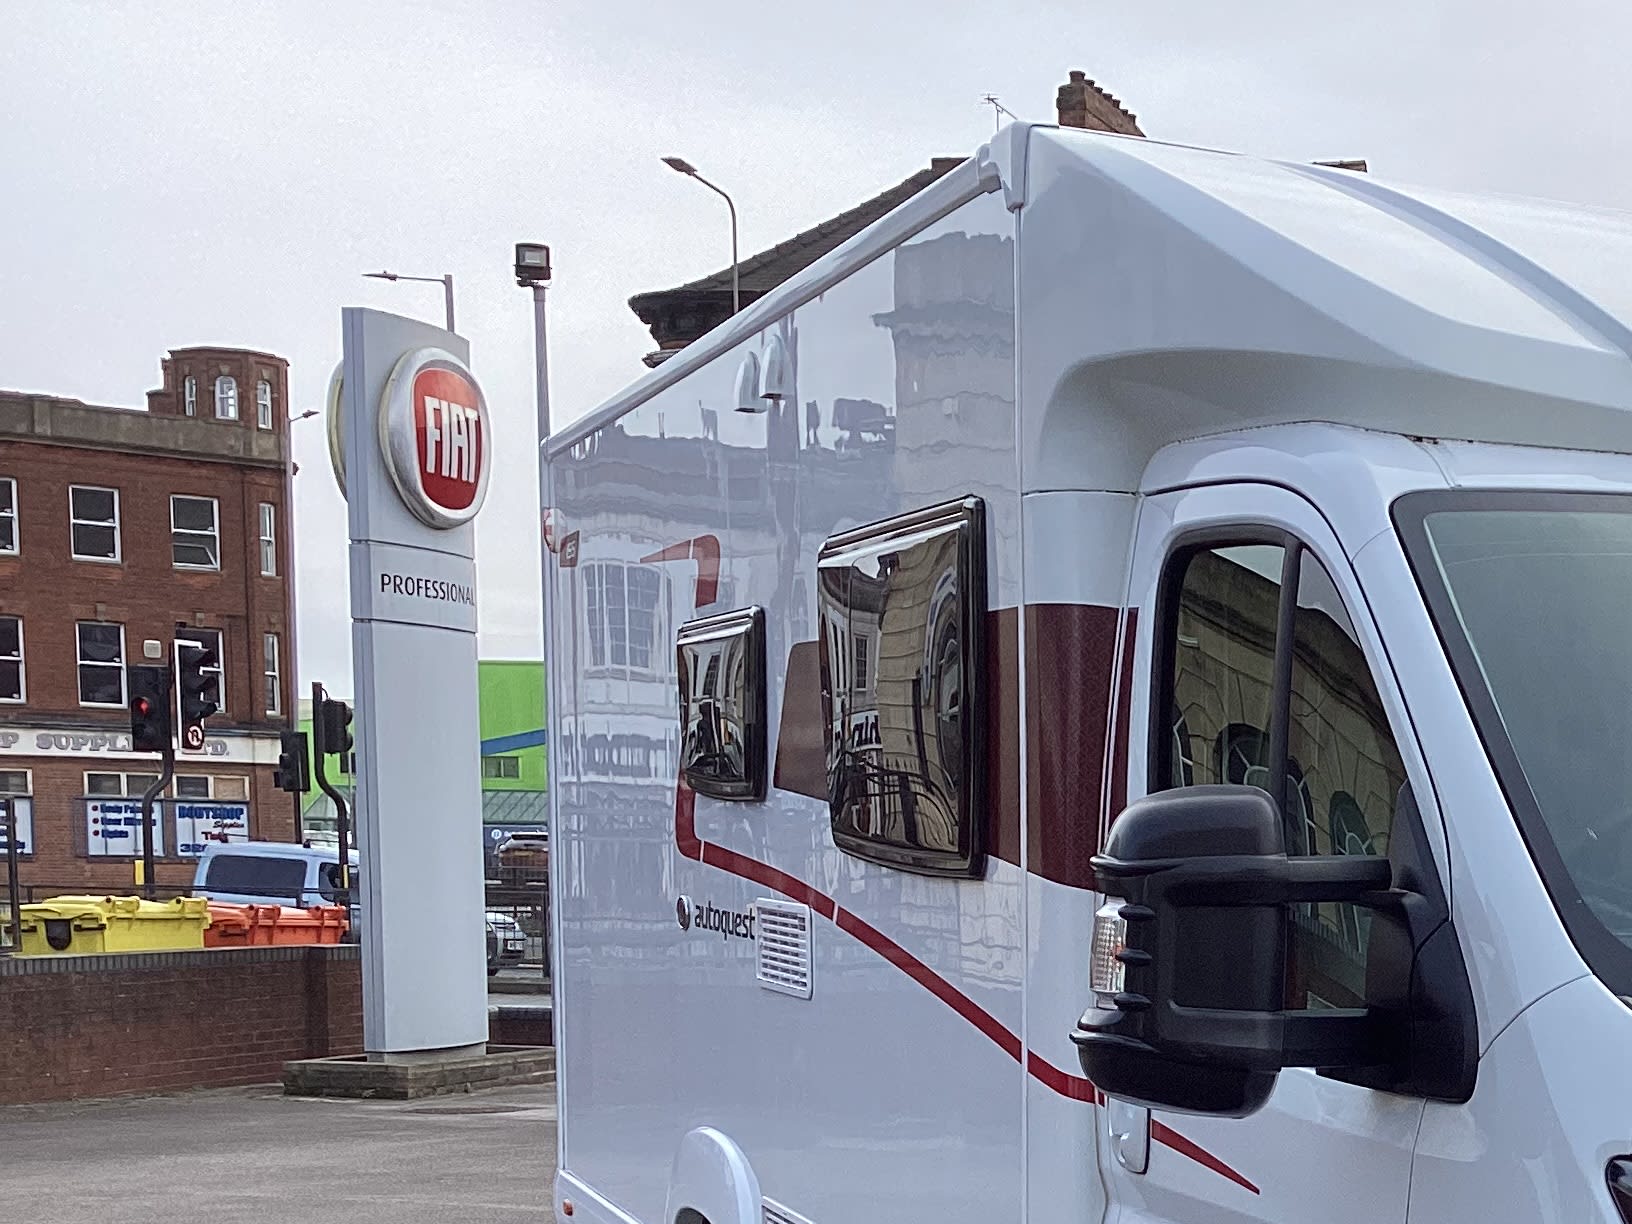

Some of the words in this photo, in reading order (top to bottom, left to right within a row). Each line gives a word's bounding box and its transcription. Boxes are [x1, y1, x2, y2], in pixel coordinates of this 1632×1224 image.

[424, 396, 479, 484] FIAT
[381, 573, 475, 607] PROFESSIONAL
[694, 901, 756, 940] autoquest
